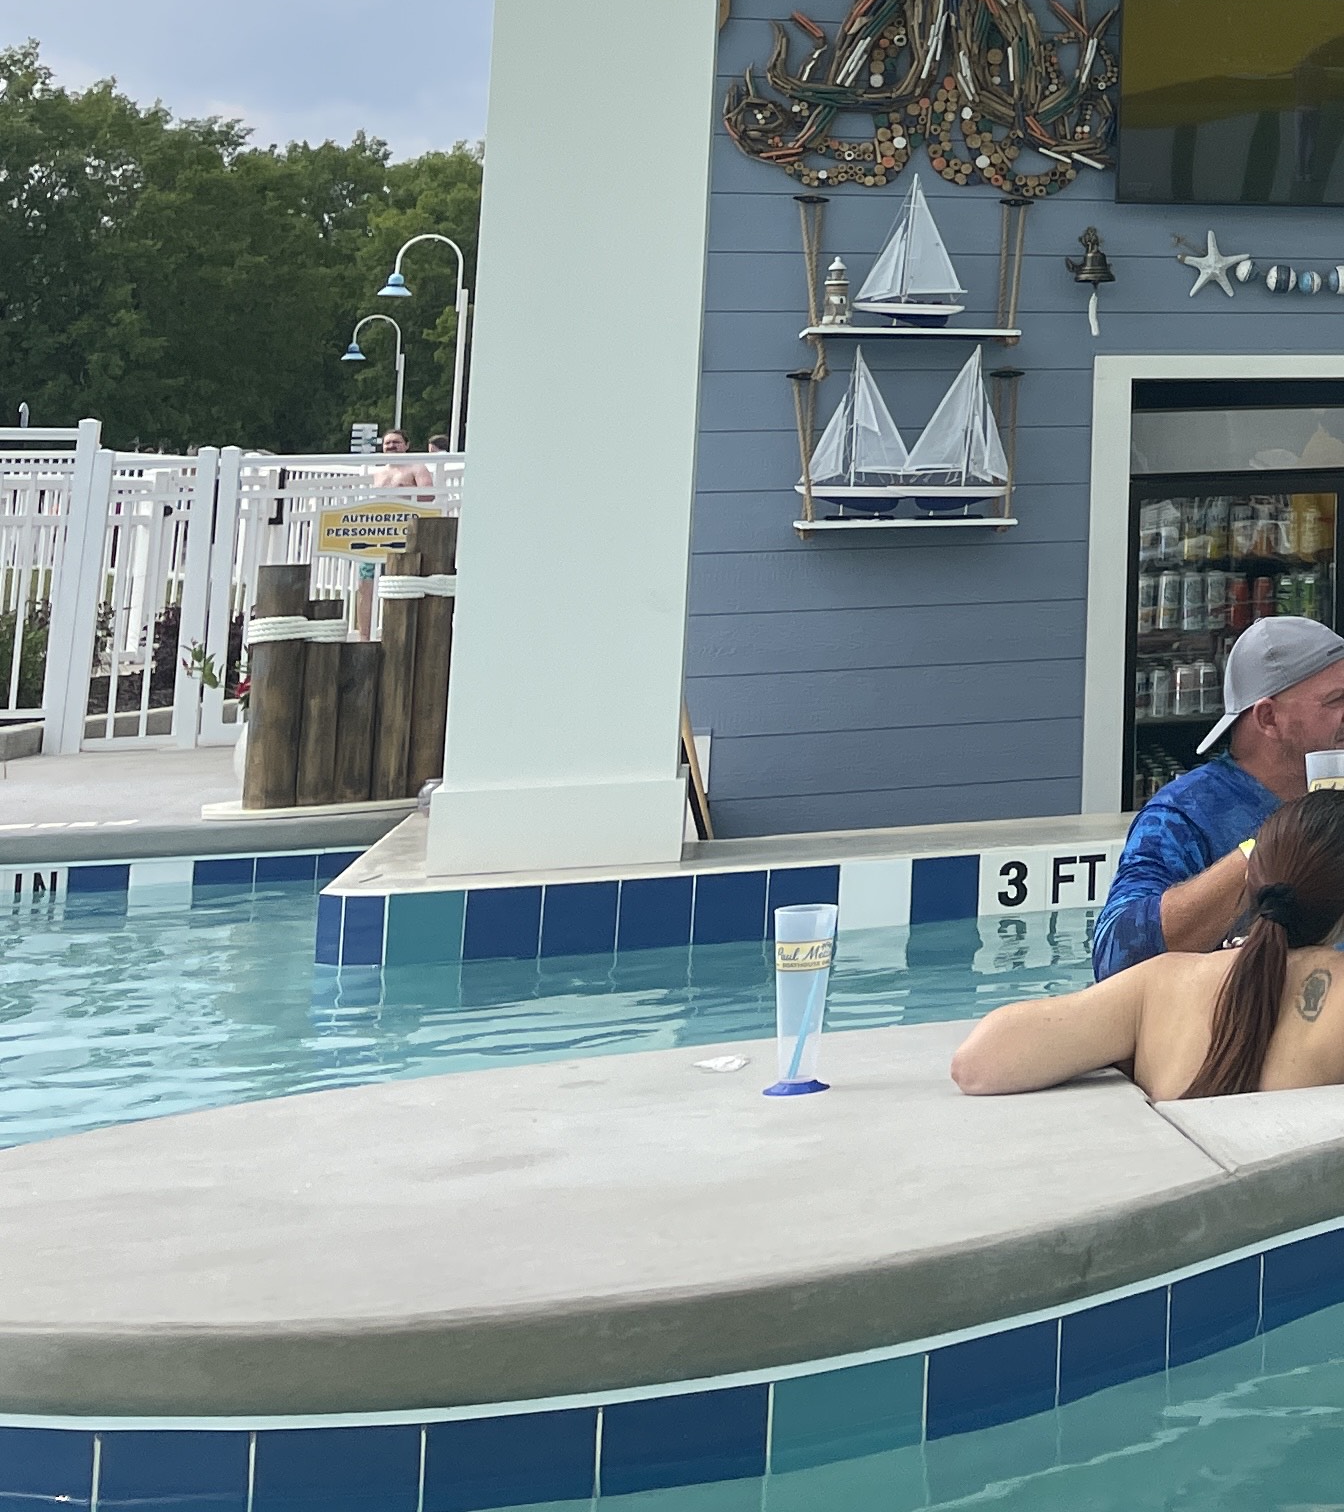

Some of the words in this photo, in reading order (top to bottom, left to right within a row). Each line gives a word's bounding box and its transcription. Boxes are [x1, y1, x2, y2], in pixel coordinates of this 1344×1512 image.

[326, 527, 399, 537] PERSONNEL
[997, 860, 1028, 907] 3
[1051, 854, 1107, 905] FT
[777, 946, 800, 961] Paul
[782, 961, 821, 969] BOATHOUSE
